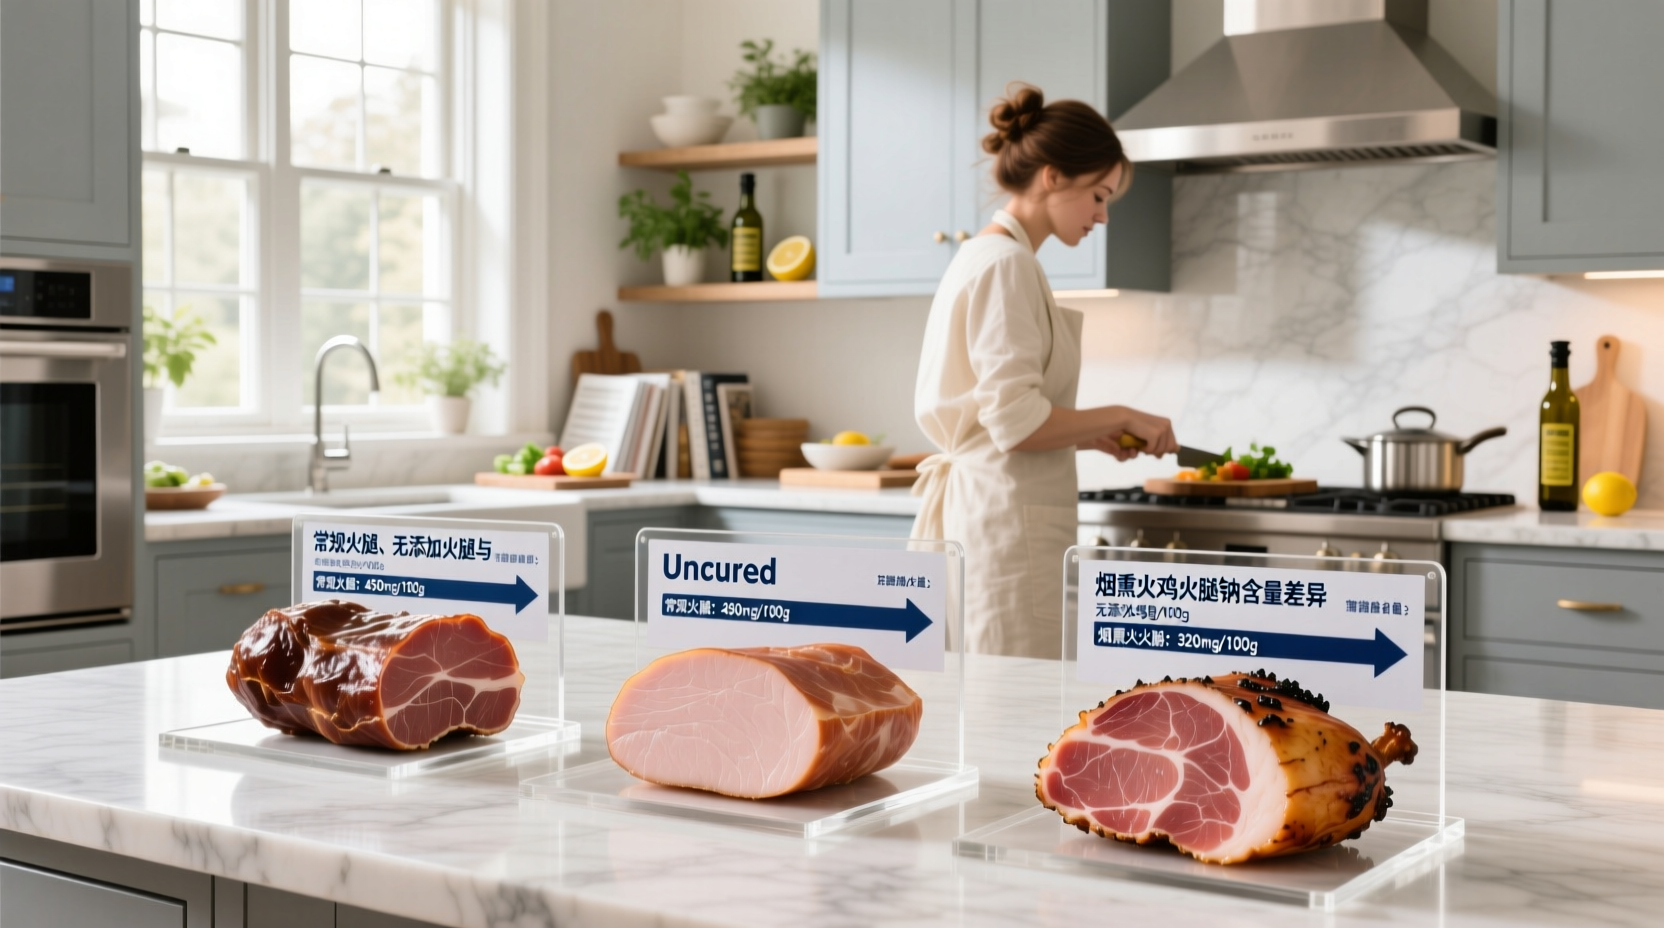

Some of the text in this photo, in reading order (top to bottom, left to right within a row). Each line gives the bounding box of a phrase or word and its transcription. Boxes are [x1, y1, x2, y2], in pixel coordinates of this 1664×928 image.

[313, 529, 492, 561] 常规火腿、无添加火腿与
[663, 553, 777, 585] Uncured
[1095, 571, 1327, 608] 烟熏火鸡火腿钠含量差异
[1177, 633, 1258, 656] 320mg/100g
